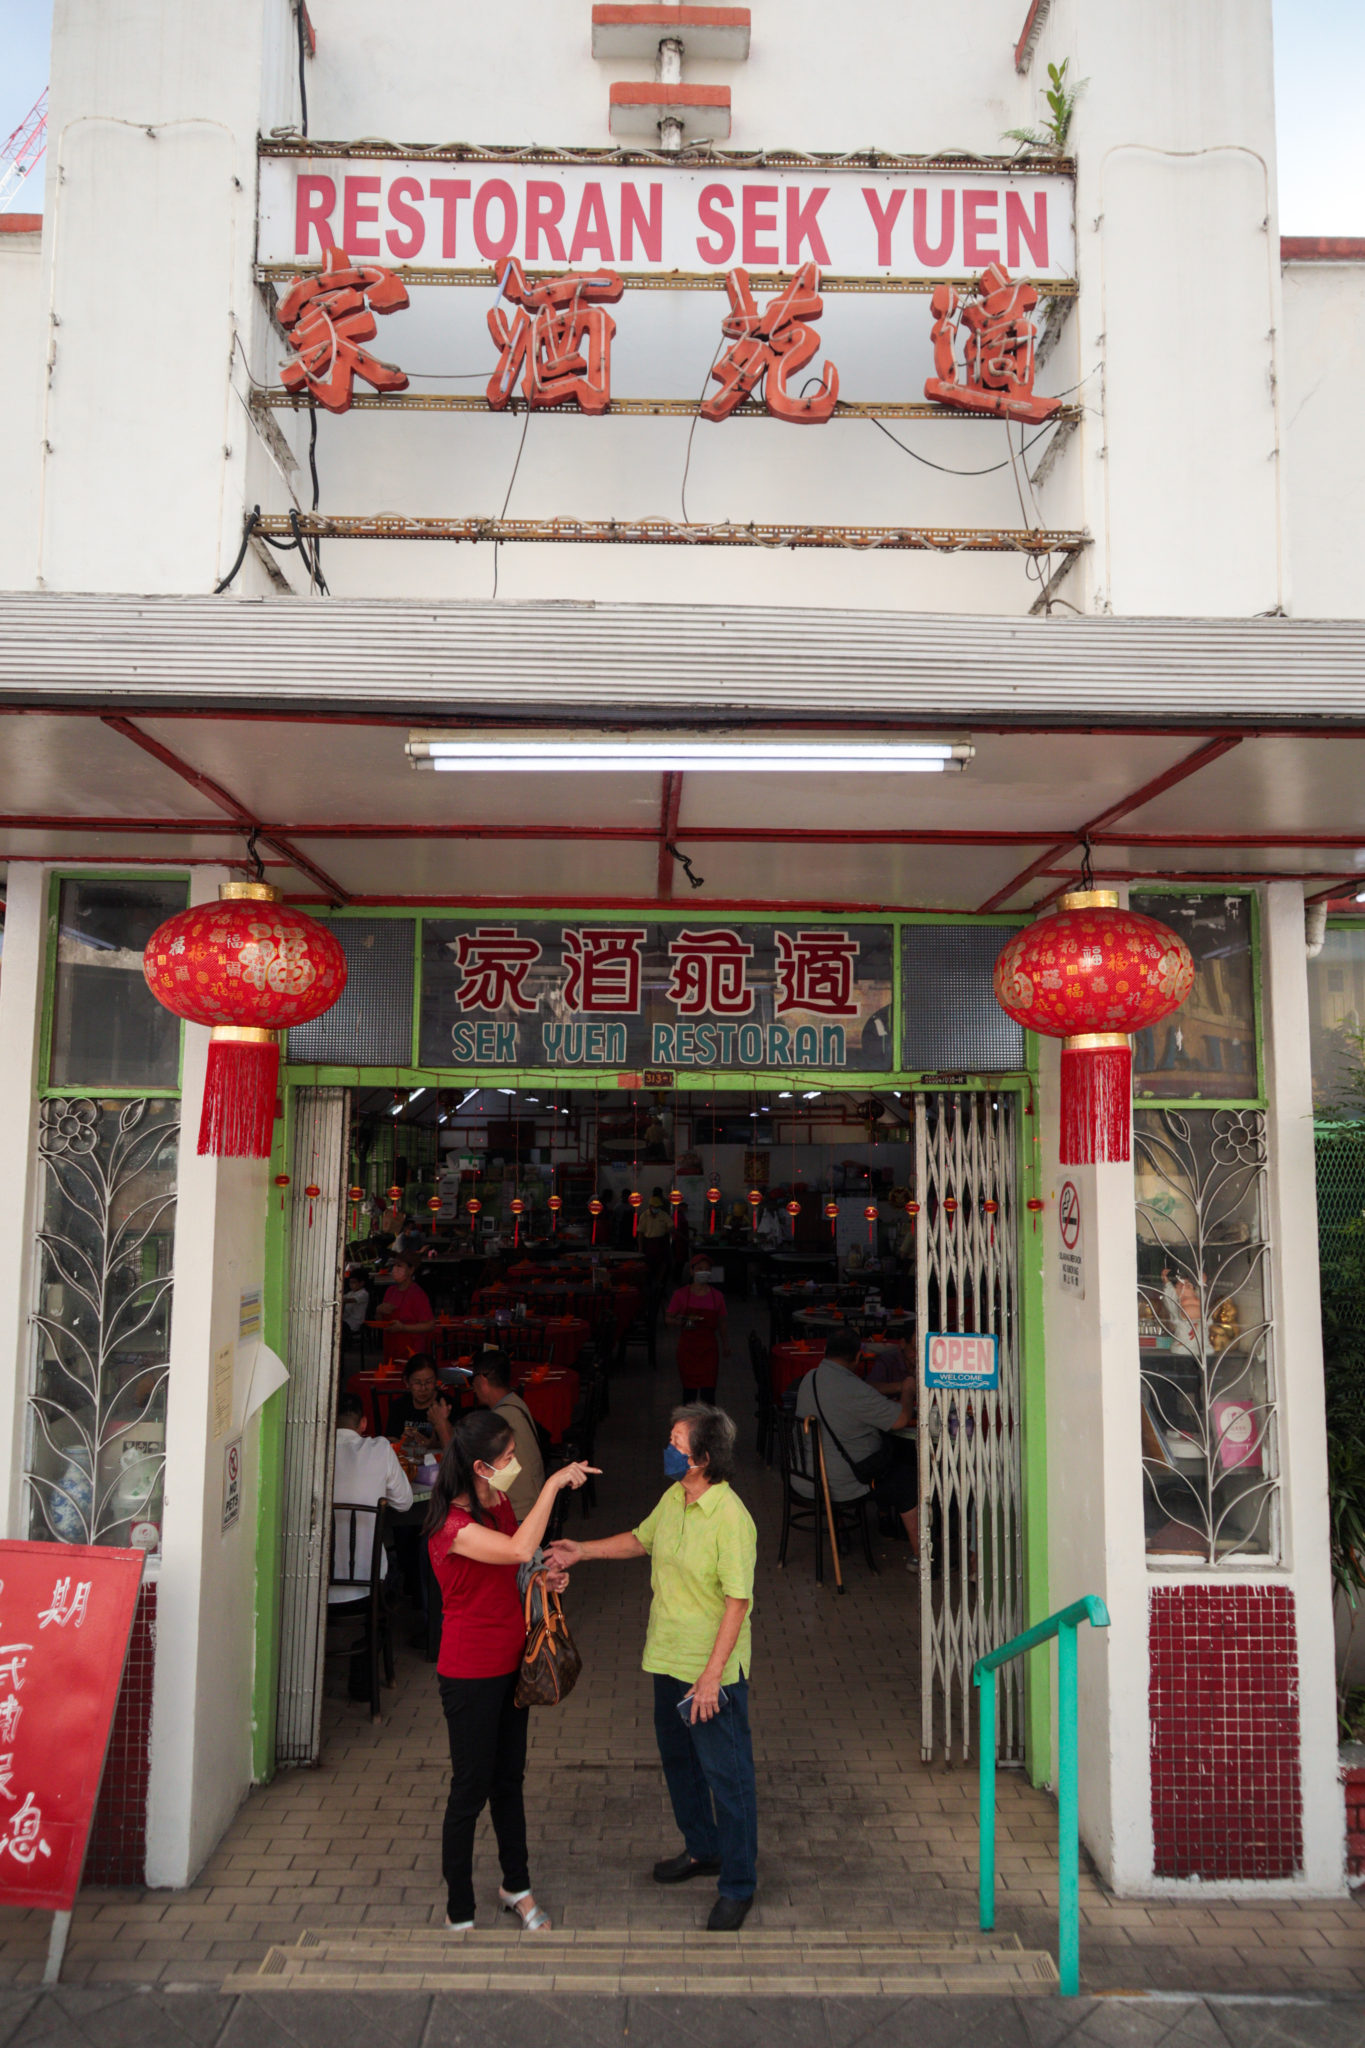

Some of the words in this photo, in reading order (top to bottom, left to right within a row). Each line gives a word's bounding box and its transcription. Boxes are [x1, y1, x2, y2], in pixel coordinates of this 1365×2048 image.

[294, 174, 663, 263] RESTORAN
[696, 183, 832, 267] SEK
[861, 187, 1050, 269] YUEN
[452, 1020, 518, 1063] SEK
[542, 1022, 627, 1063] YUEN
[652, 1022, 847, 1065] RESTORAN
[932, 1338, 993, 1373] OPEN
[940, 1374, 983, 1382] WELCOME
[225, 1494, 239, 1514] PETS
[37, 1576, 92, 1629] 期
